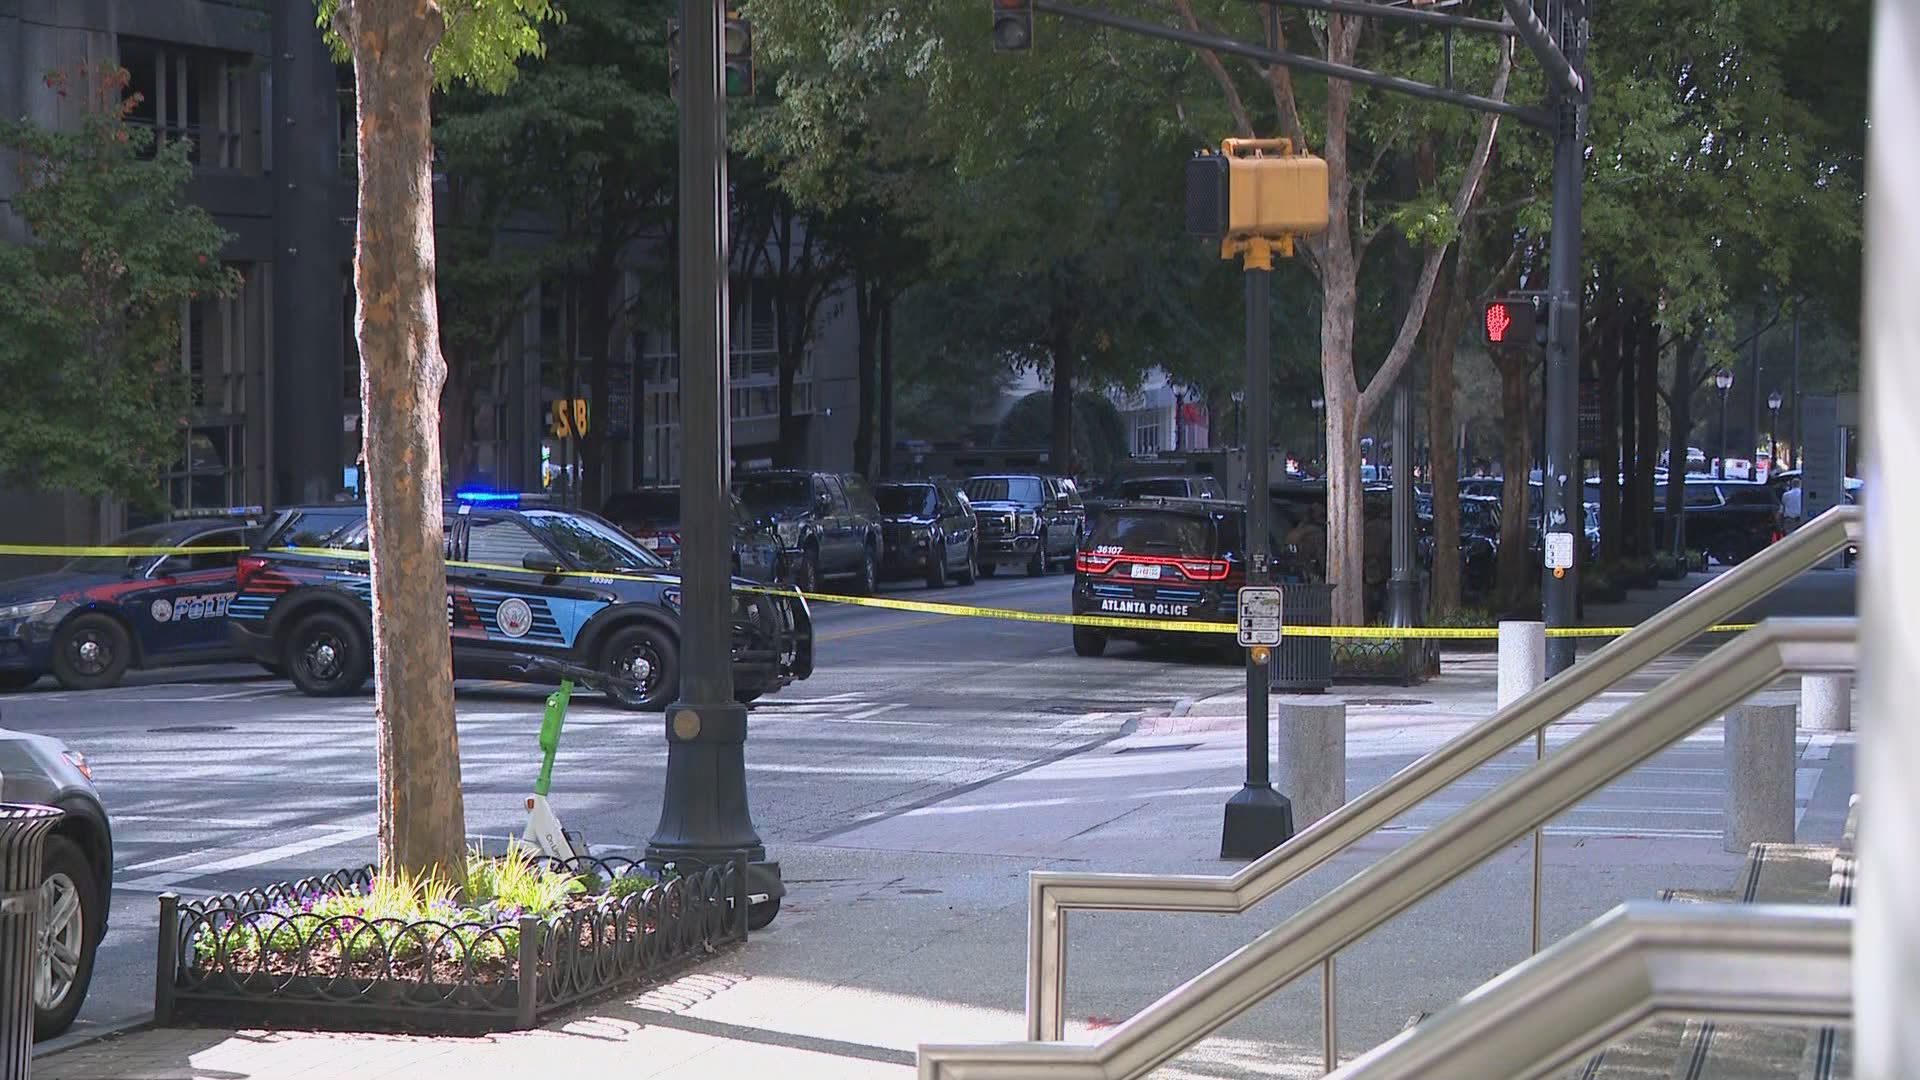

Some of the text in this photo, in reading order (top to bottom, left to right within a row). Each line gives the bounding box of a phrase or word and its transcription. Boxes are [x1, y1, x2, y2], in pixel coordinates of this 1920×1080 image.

[1096, 545, 1123, 555] 36107
[1101, 599, 1189, 616] ATLANTA POLICE
